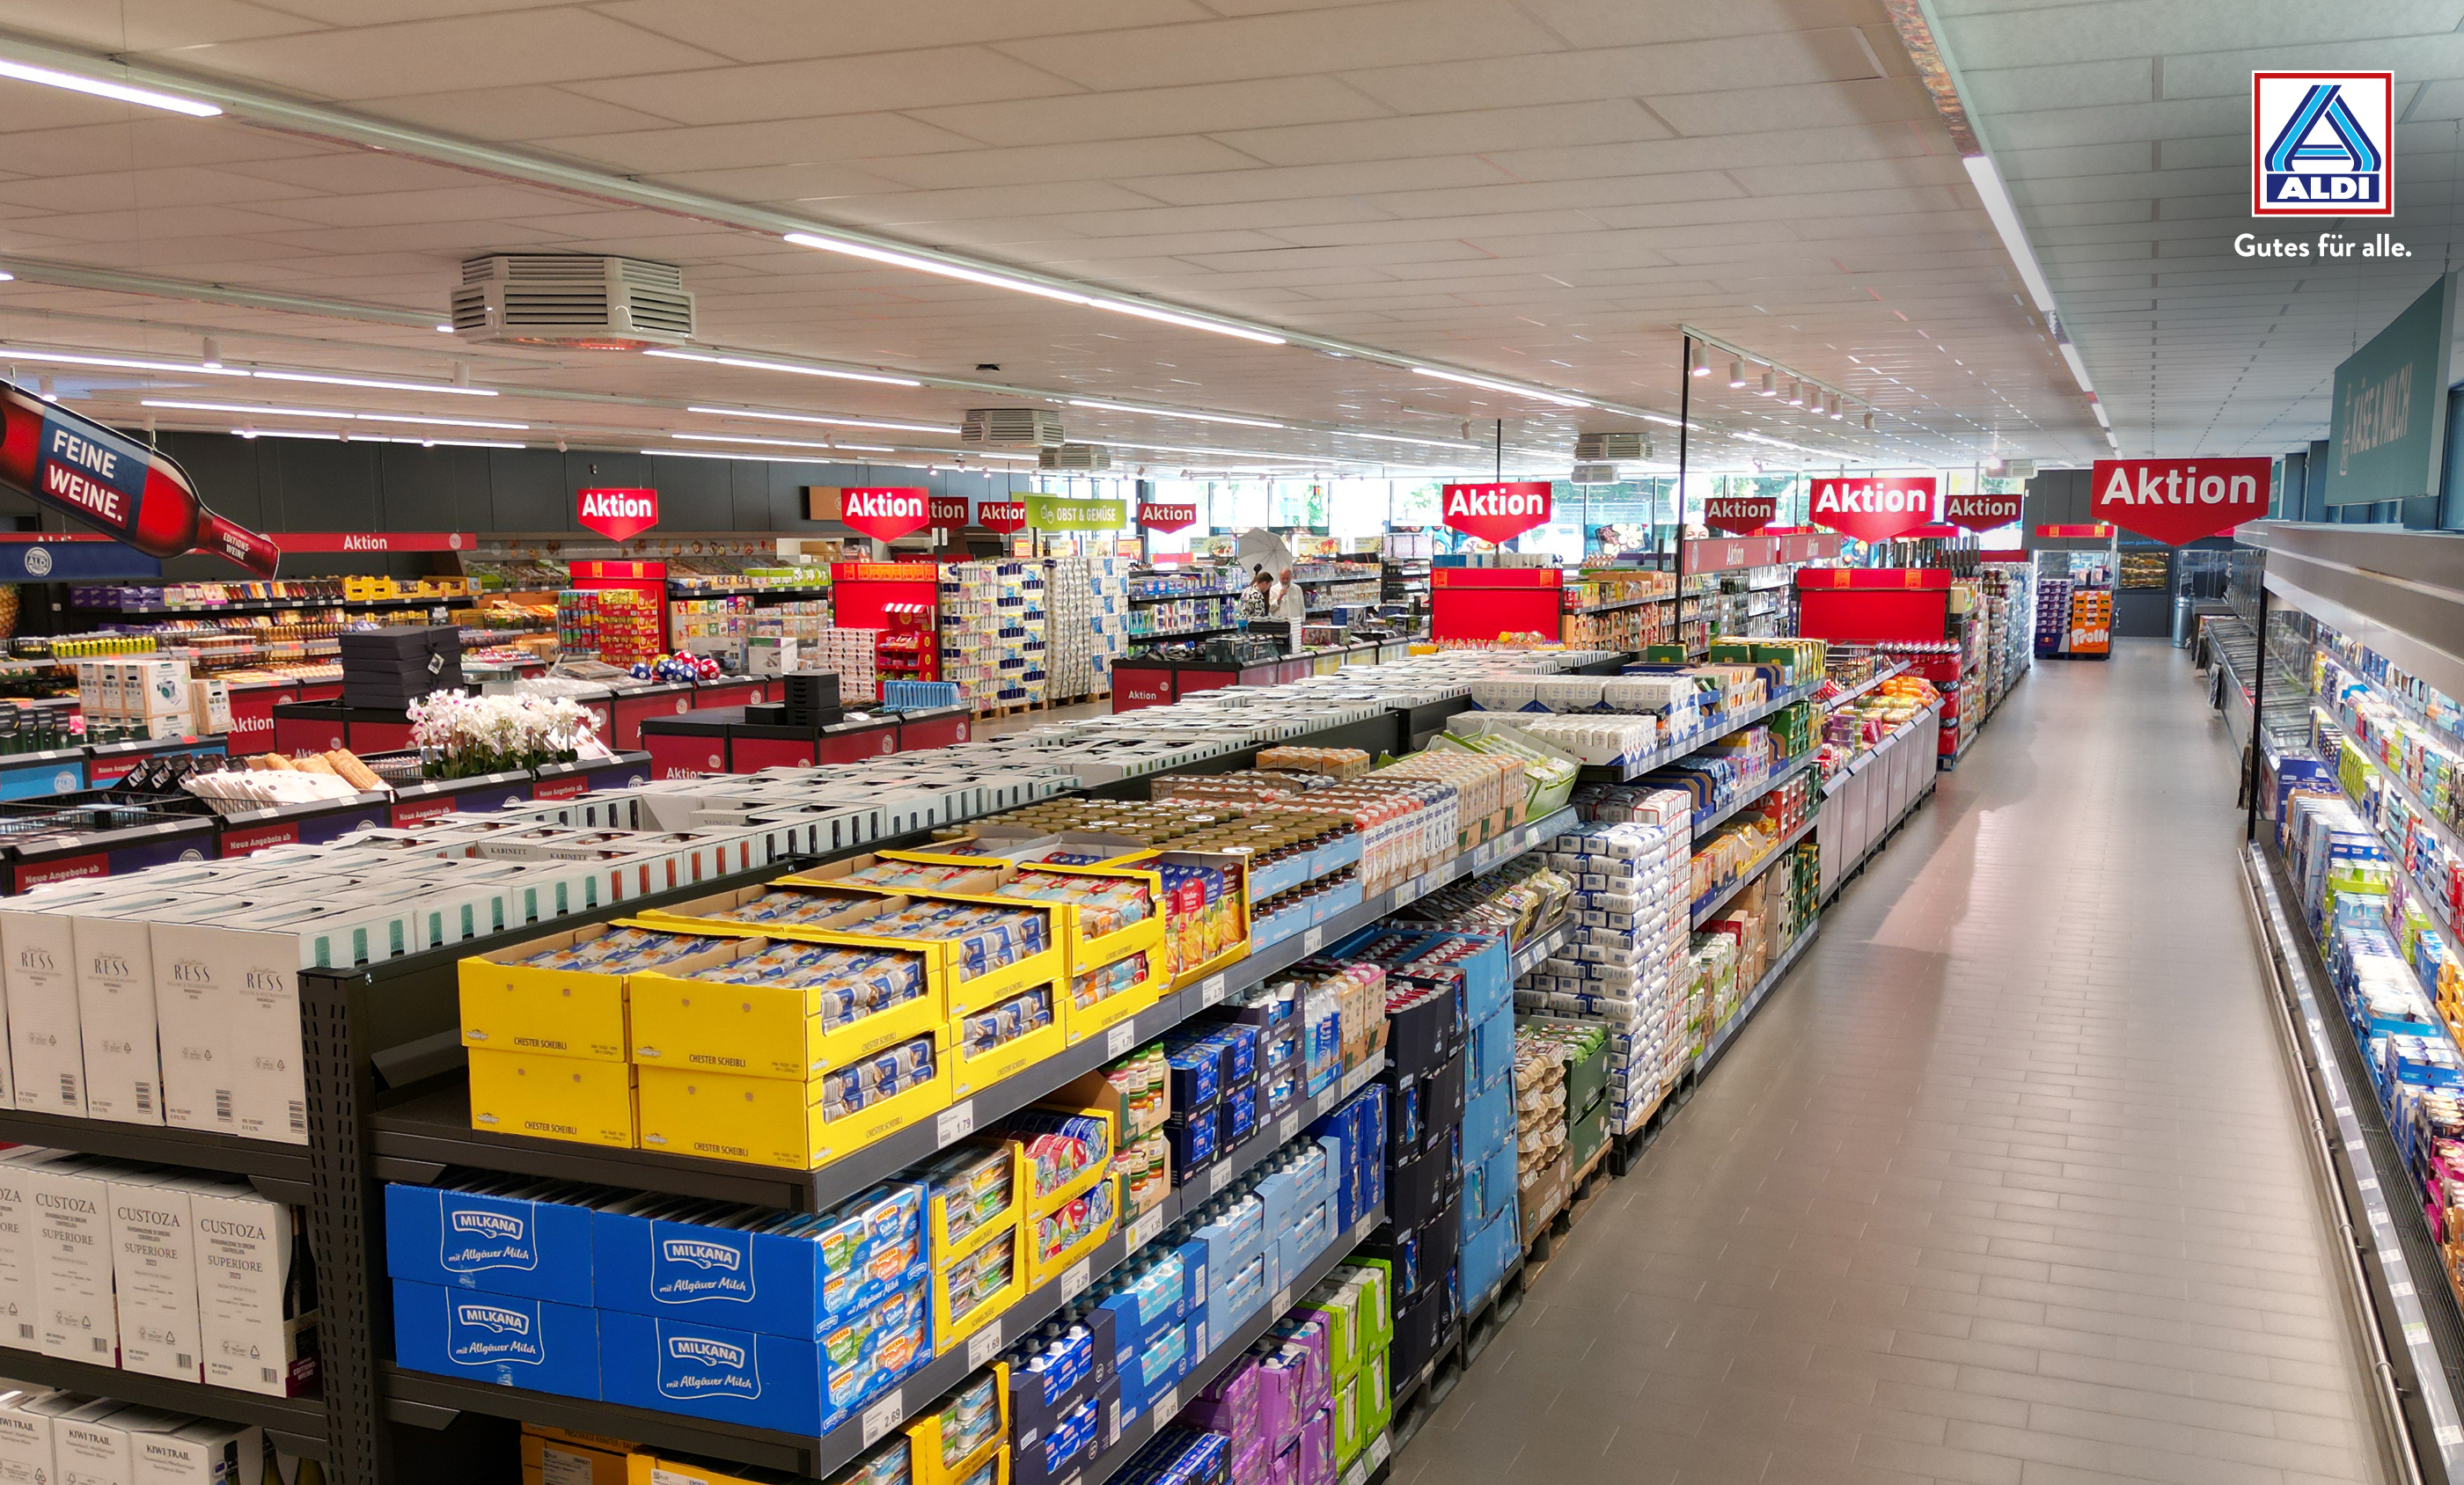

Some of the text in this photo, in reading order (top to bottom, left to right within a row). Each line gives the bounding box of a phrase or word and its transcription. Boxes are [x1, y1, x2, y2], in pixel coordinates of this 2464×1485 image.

[2380, 362, 2413, 446] MILCH
[53, 429, 117, 479] FEINE
[49, 465, 123, 522] WEINE.
[2101, 466, 2257, 505] Aktion
[582, 494, 652, 517] Aktion
[846, 492, 922, 517] Aktion
[1448, 487, 1544, 516] Aktion
[1815, 483, 1927, 513] Aktion
[1947, 498, 2017, 516] Aktion
[1057, 505, 1116, 523] OBST & GEMÜSE
[1142, 506, 1193, 521] Aktion
[1707, 501, 1771, 519] Aktion
[223, 532, 251, 552] EDITIONS-
[226, 542, 246, 560] WEINE
[344, 535, 387, 550] Aktion
[27, 555, 49, 568] ALDI
[1727, 543, 1744, 566] Aktion
[2071, 629, 2108, 647] Trolli
[1128, 691, 1156, 700] Aktion
[553, 786, 576, 795] Angebote
[399, 812, 414, 821] Neue
[415, 808, 442, 820] Angebote
[231, 832, 291, 850] Neue Angebote ab
[490, 846, 528, 856] KABINETT
[25, 864, 99, 884] Neue Angebote ab
[21, 952, 55, 970] RESS
[94, 958, 129, 977] RESS
[174, 964, 210, 983] RESS
[247, 972, 283, 991] RESS
[514, 1037, 539, 1048] CHESTER
[540, 1039, 568, 1050] SCHEIBLI
[689, 1054, 746, 1068] CHESTER SCHEIBLI
[524, 1121, 577, 1135] CHESTER SCHEIBLI
[956, 1117, 972, 1134] 1.79
[693, 1142, 749, 1157] CHESTER SCHEIBLI
[35, 1193, 97, 1214] CUSTOZA
[118, 1206, 180, 1227] CUSTOZA
[876, 1206, 897, 1220] MILKANA
[201, 1218, 266, 1240] CUSTOZA
[460, 1214, 517, 1233] MILKANA
[42, 1228, 94, 1246] SUPERIORE
[822, 1233, 843, 1247] MILKANA
[124, 1242, 178, 1259] SUPERIORE
[448, 1246, 530, 1263] mit Allgäuer Milch
[671, 1245, 733, 1263] MILKANA
[877, 1248, 898, 1262] MILKANA
[208, 1255, 263, 1273] SUPERIORE
[659, 1277, 747, 1293] mit Allgäuer Milch
[824, 1279, 844, 1293] MILKANA
[856, 1291, 884, 1312] Allgäuer
[883, 1278, 899, 1297] Milch
[466, 1309, 523, 1328] MILKANA
[829, 1328, 850, 1346] MILKANA
[884, 1337, 906, 1355] MILKANA
[986, 1336, 1001, 1353] 1.69
[456, 1340, 537, 1357] mit Allgäuer Milch
[678, 1342, 737, 1362] MILKANA
[297, 1369, 314, 1380] WEINE
[666, 1374, 752, 1391] mit Allgäuer Milch
[832, 1372, 852, 1390] MILKANA
[13, 1419, 35, 1431] TRAIL
[884, 1408, 901, 1428] 2.69
[69, 1429, 112, 1445] KIWI TRAIL
[146, 1445, 191, 1460] KIWI TRAIL
